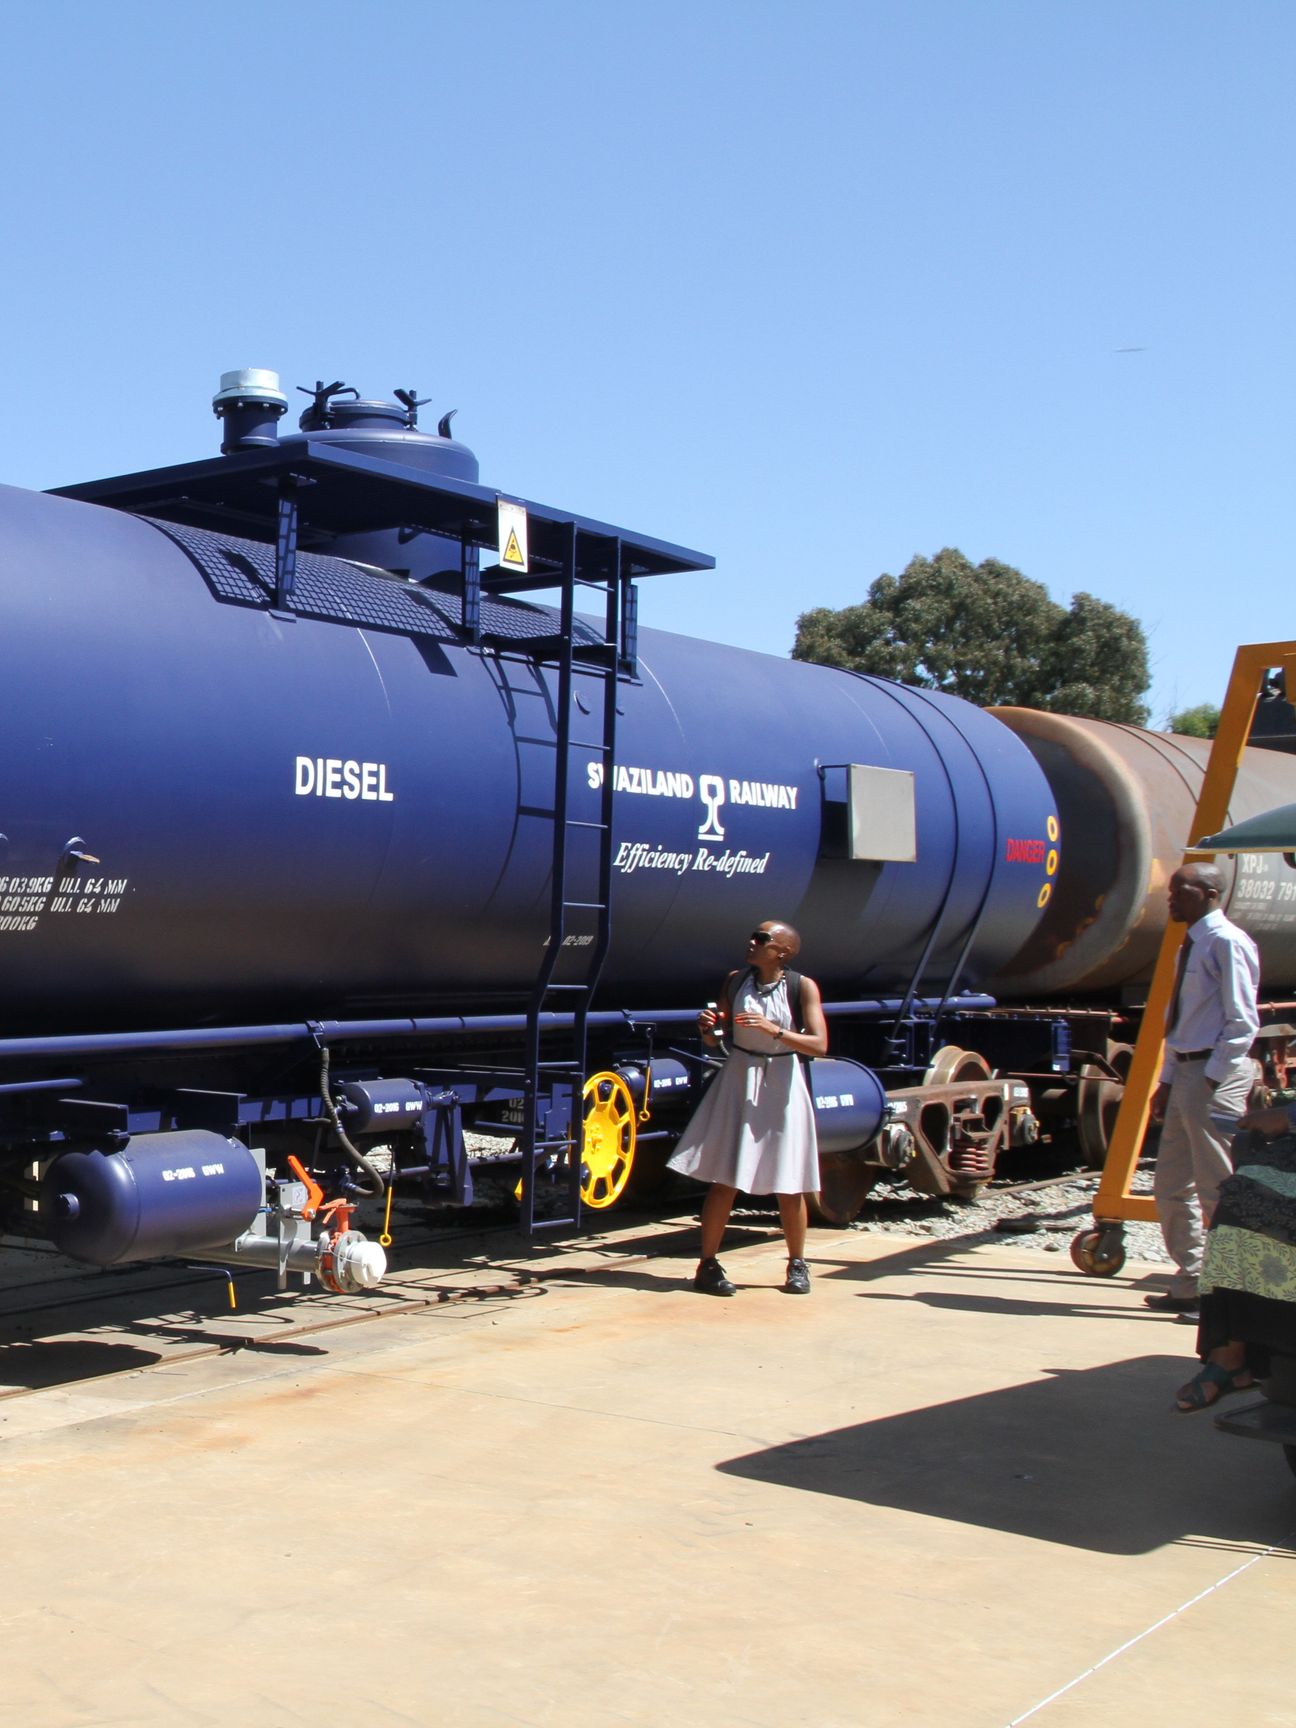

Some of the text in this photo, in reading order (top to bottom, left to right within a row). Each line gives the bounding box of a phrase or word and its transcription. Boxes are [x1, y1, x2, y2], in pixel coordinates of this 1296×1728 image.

[295, 756, 394, 801] DIESEL
[729, 779, 798, 810] RAILWAY
[613, 842, 770, 878] Efficiency Re-defined
[1006, 838, 1045, 863] DANGER
[84, 878, 104, 894] 64
[104, 879, 128, 895] MM
[76, 898, 95, 913] 64
[97, 899, 120, 914] MM
